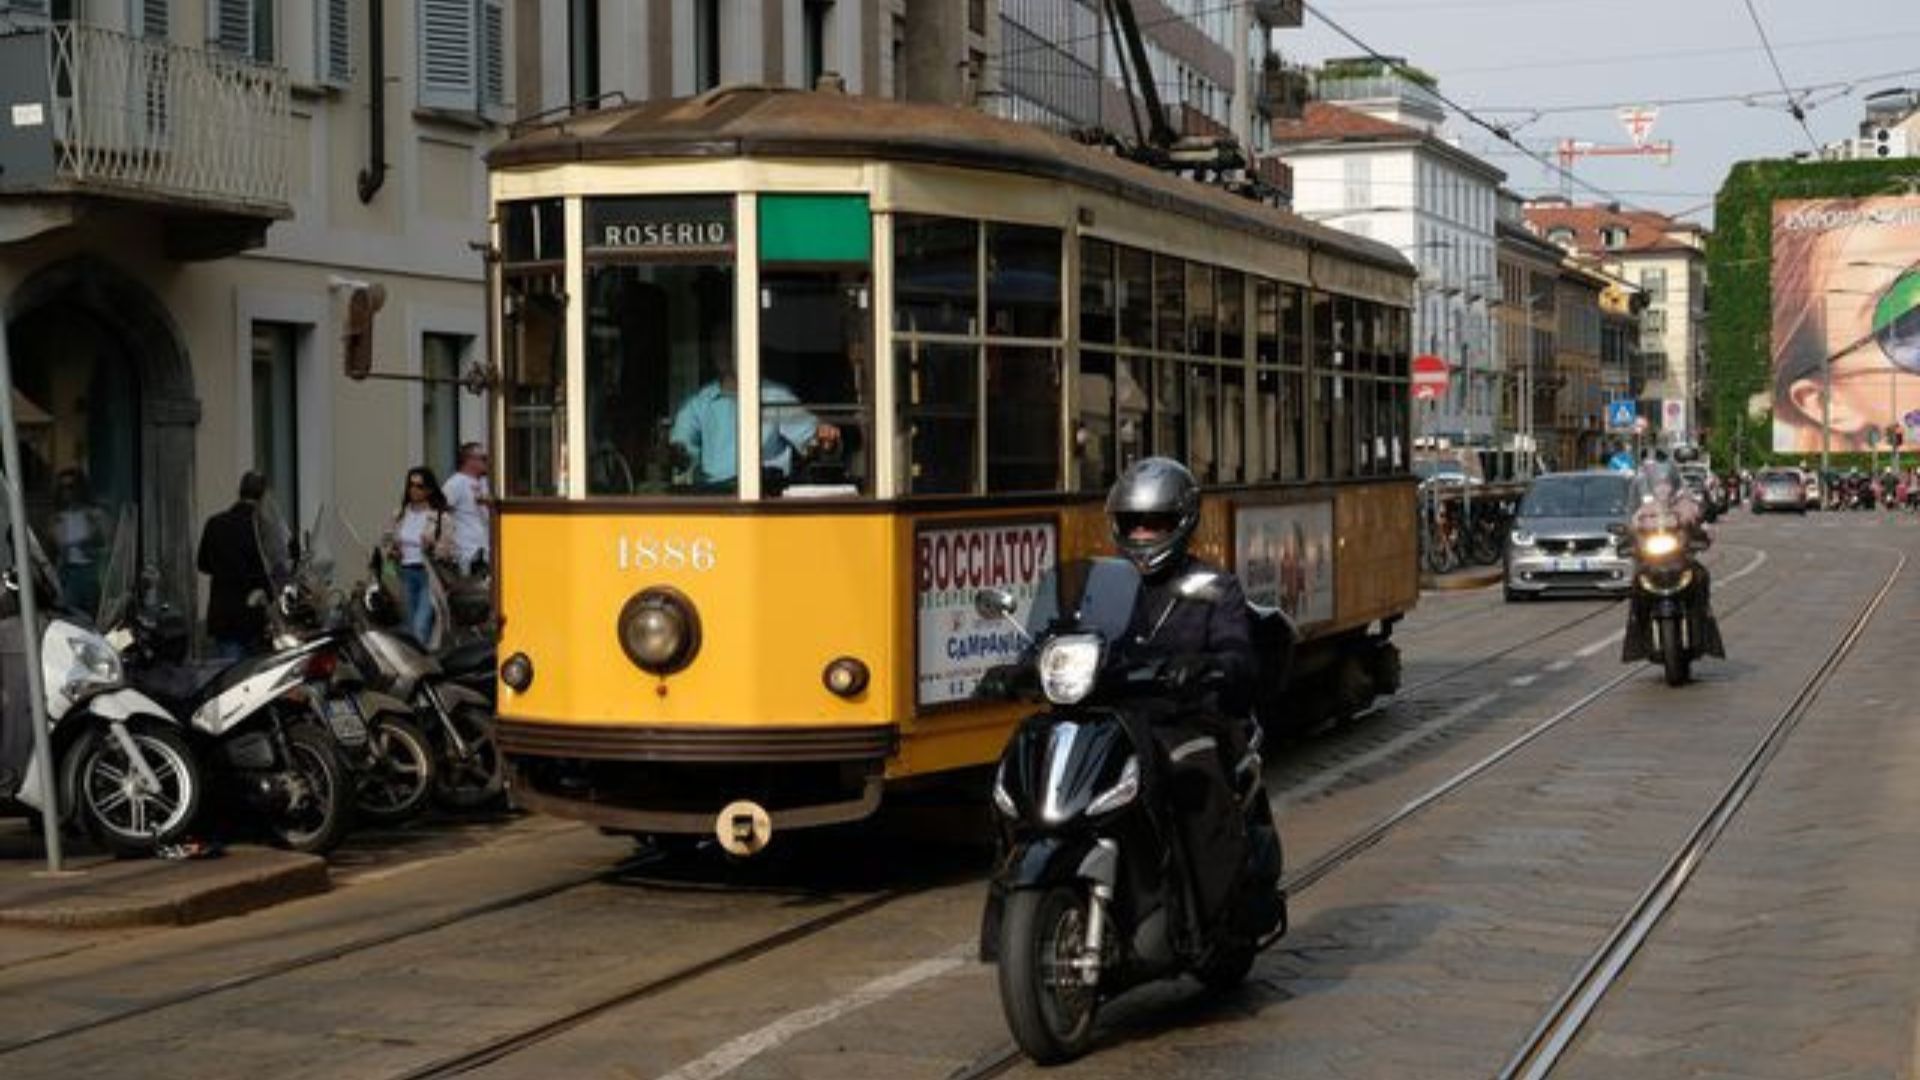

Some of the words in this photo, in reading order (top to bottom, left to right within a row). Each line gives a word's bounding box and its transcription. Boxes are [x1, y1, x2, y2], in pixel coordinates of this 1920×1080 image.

[604, 222, 725, 247] ROSERIO
[617, 534, 716, 572] 1886
[917, 529, 1047, 592] BOCCIATO?
